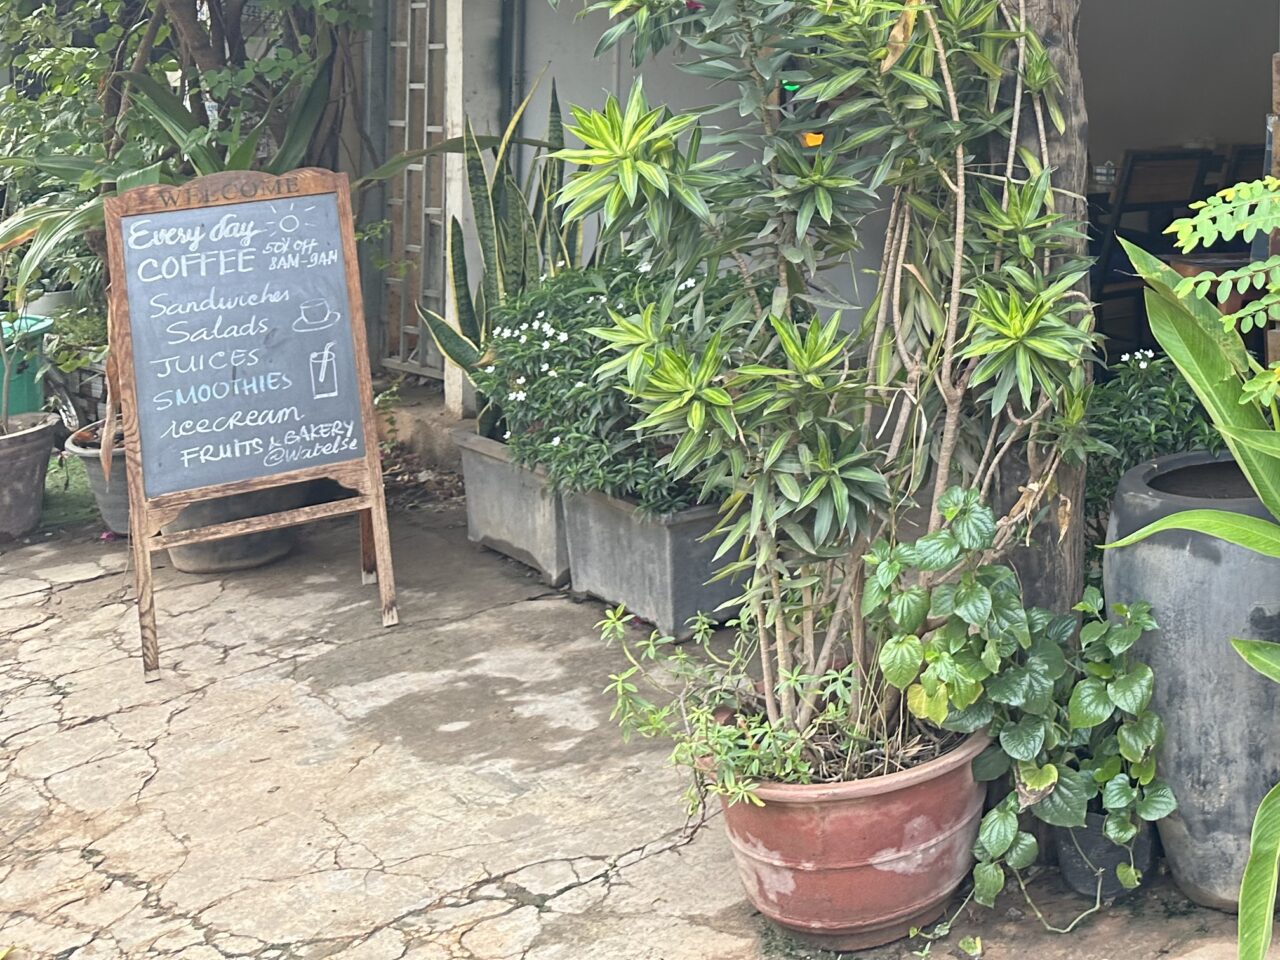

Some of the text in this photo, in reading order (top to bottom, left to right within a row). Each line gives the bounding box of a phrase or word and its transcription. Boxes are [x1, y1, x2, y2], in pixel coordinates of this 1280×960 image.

[158, 177, 300, 208] WELCOME
[128, 214, 265, 251] Every day
[137, 248, 256, 282] COFFEE
[150, 282, 290, 318] Sandwiches
[166, 315, 269, 344] Salads
[149, 348, 260, 377] JUICES
[152, 372, 293, 410] SMOOTHIES
[284, 420, 355, 445] BAKERY
